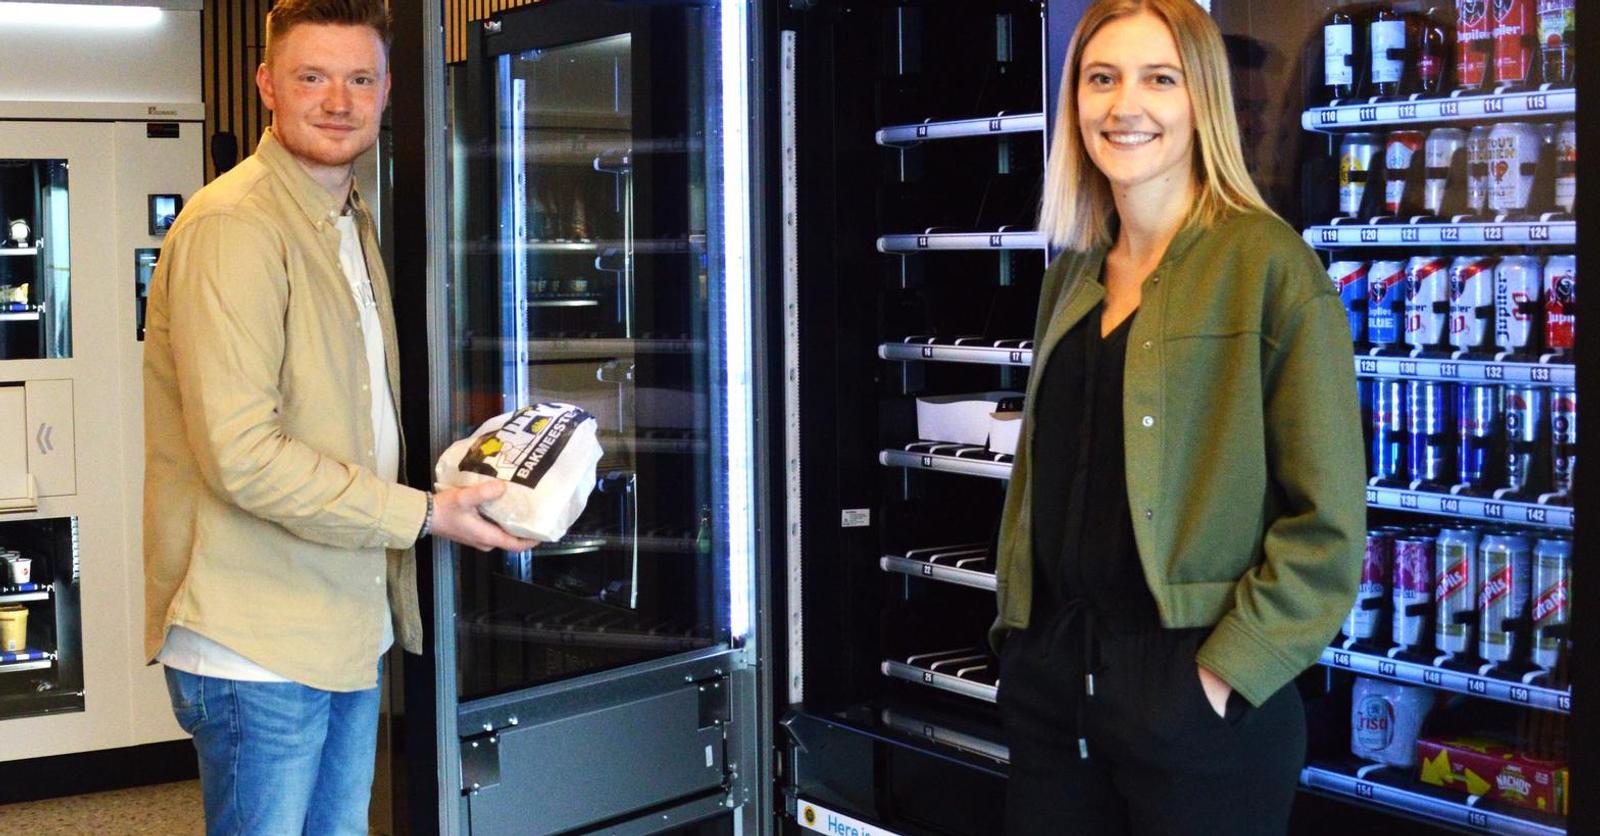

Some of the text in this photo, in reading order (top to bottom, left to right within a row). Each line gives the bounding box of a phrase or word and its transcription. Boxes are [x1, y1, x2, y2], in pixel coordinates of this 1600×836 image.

[1321, 96, 1545, 122] 110 111 112 113 114 115
[1322, 226, 1547, 241] 119 120 121 122 123 124
[1497, 272, 1510, 341] Jupiler
[1011, 352, 1020, 361] 17
[1361, 360, 1549, 381] 129 130 131 132 133
[1366, 491, 1545, 521] 38 139 140 141 142
[1334, 653, 1571, 708] 146 147 148 149 150 15
[1496, 773, 1531, 796] NACHOS
[1356, 784, 1487, 826] 154 155
[828, 814, 859, 836] Here
